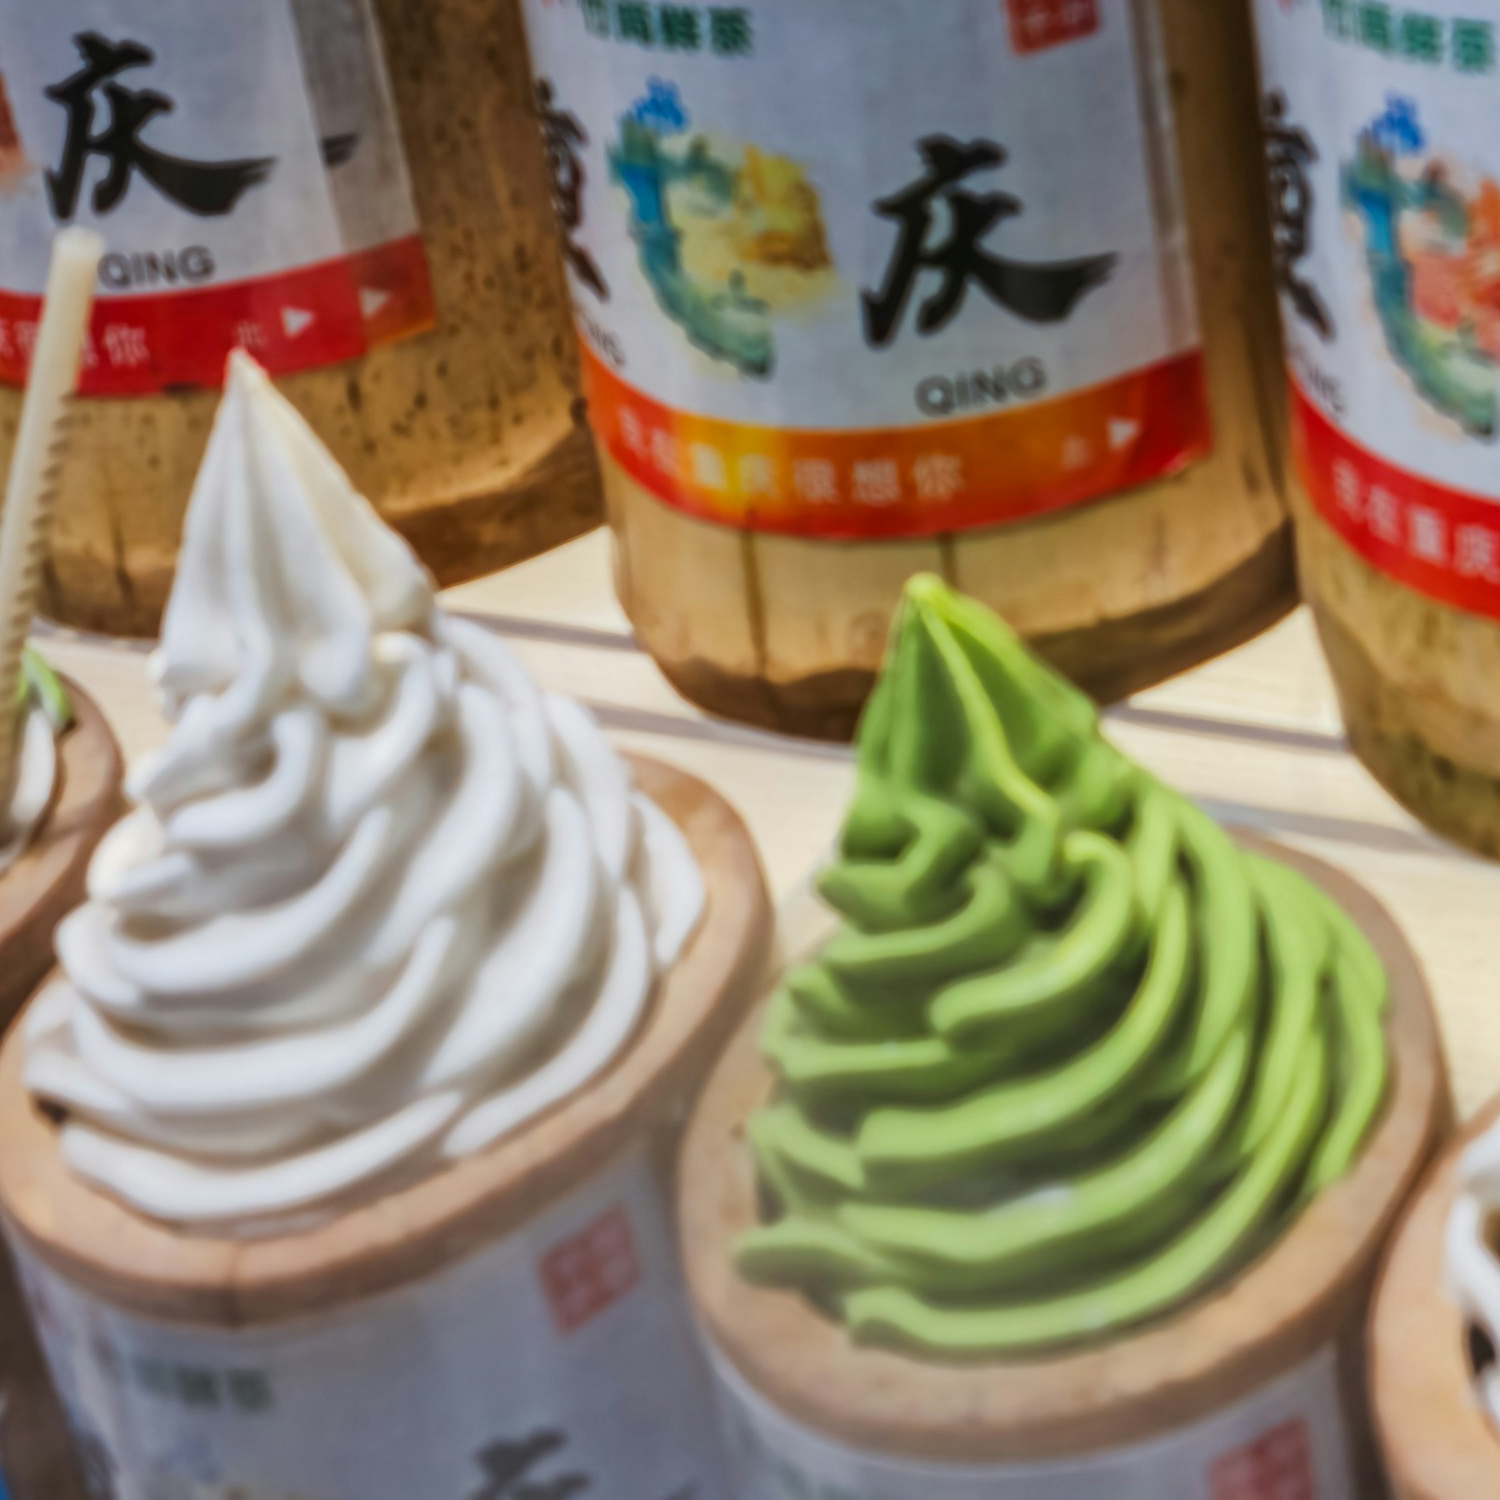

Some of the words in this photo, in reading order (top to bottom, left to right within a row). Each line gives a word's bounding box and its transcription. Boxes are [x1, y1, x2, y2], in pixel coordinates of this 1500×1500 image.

[43, 30, 279, 222] 庆
[97, 244, 217, 291] QING
[859, 134, 1122, 350] 庆
[914, 356, 1049, 419] QING
